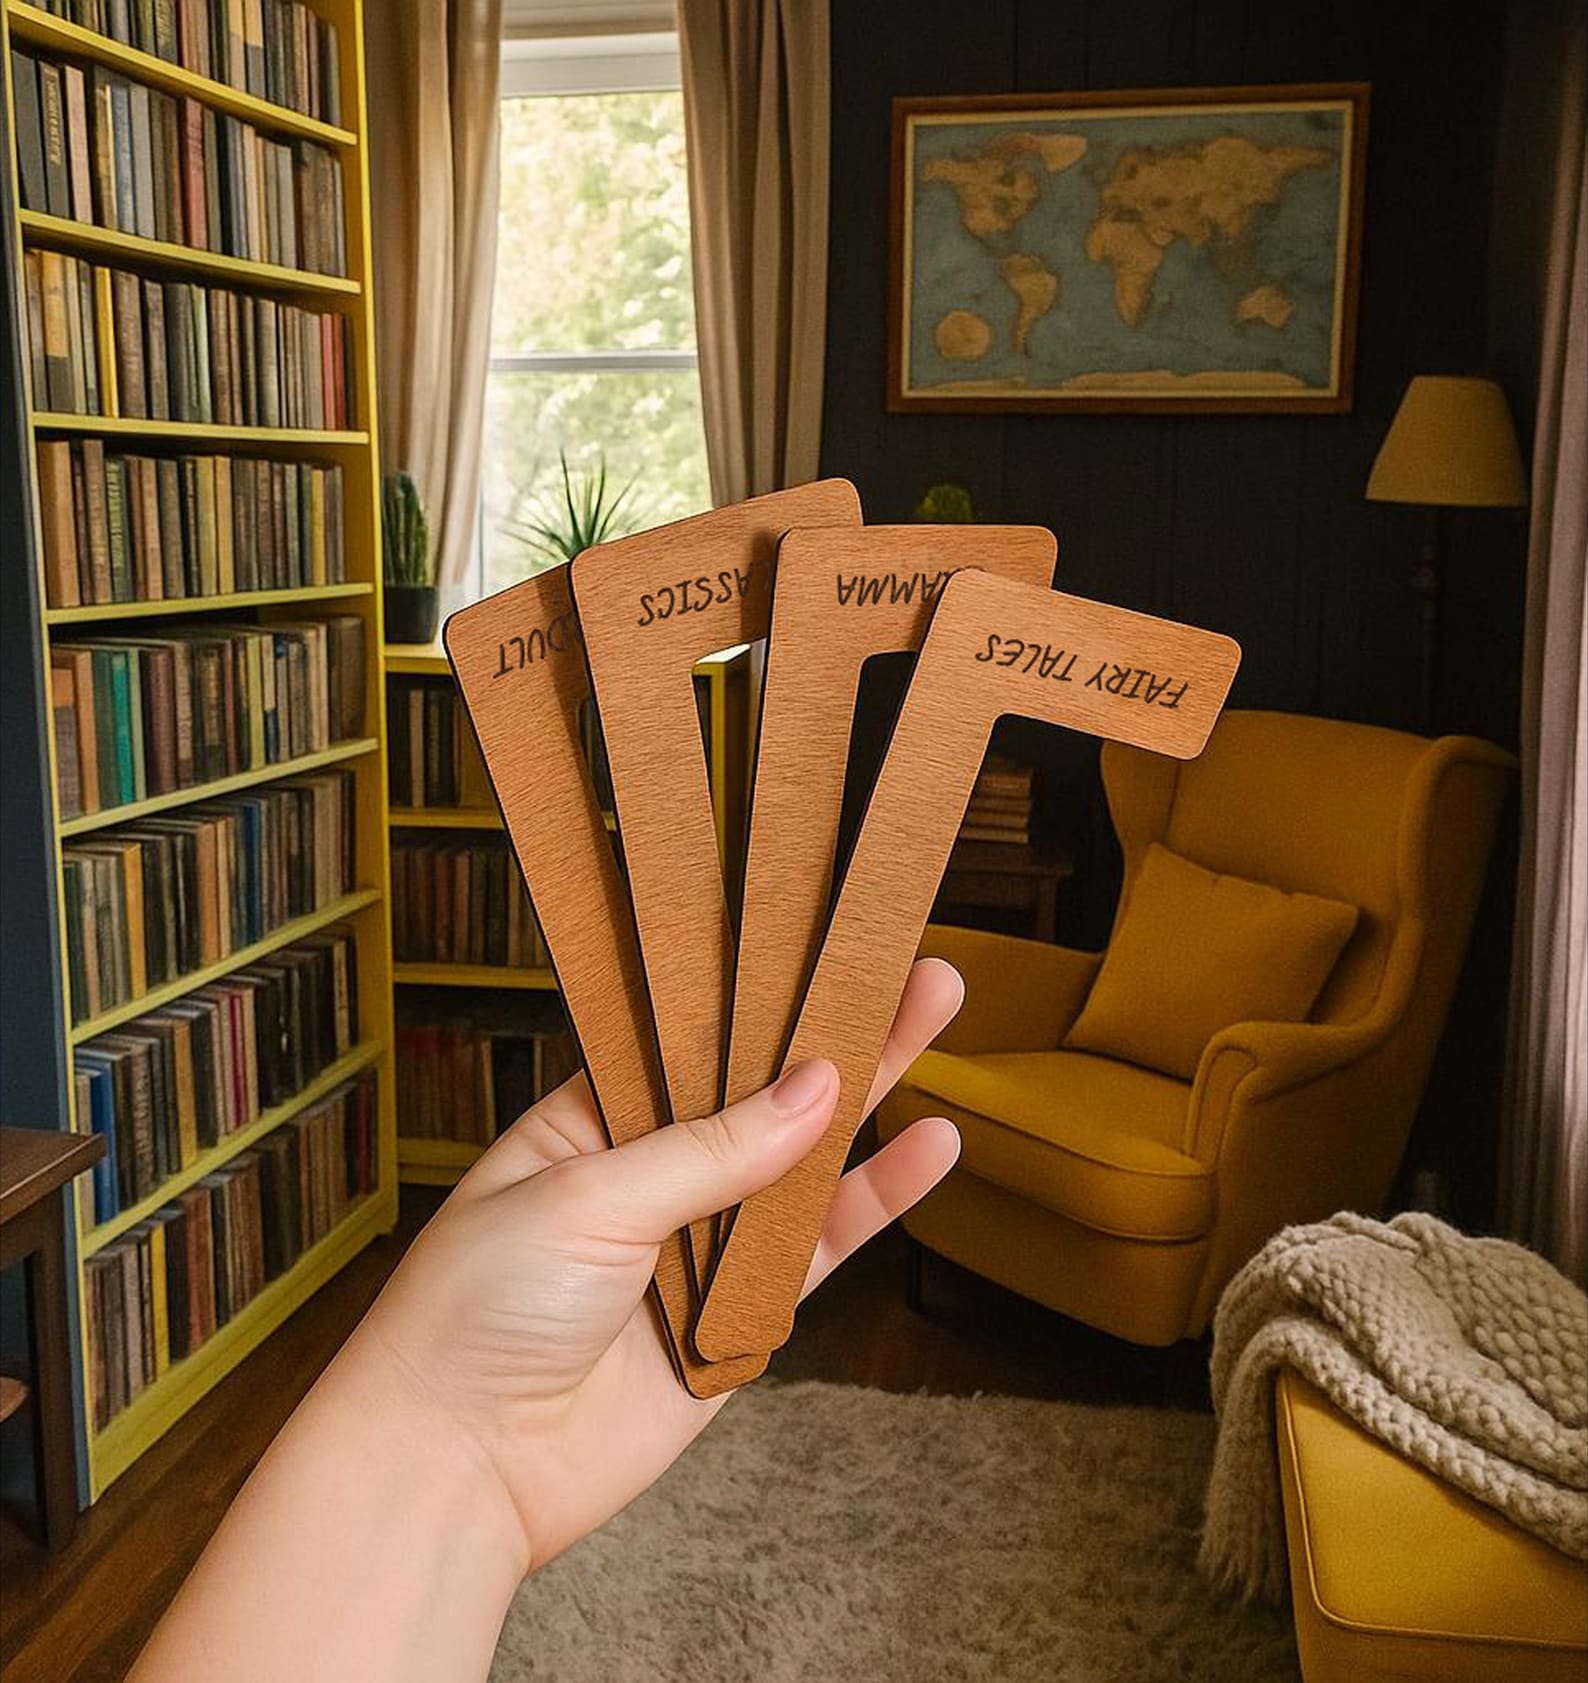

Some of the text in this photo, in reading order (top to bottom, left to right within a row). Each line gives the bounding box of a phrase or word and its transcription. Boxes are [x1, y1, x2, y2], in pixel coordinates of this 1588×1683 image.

[637, 559, 771, 627] LASSICS
[836, 570, 949, 607] AMMA
[492, 615, 580, 680] DULT
[975, 633, 1189, 709] FAIRY TALES
